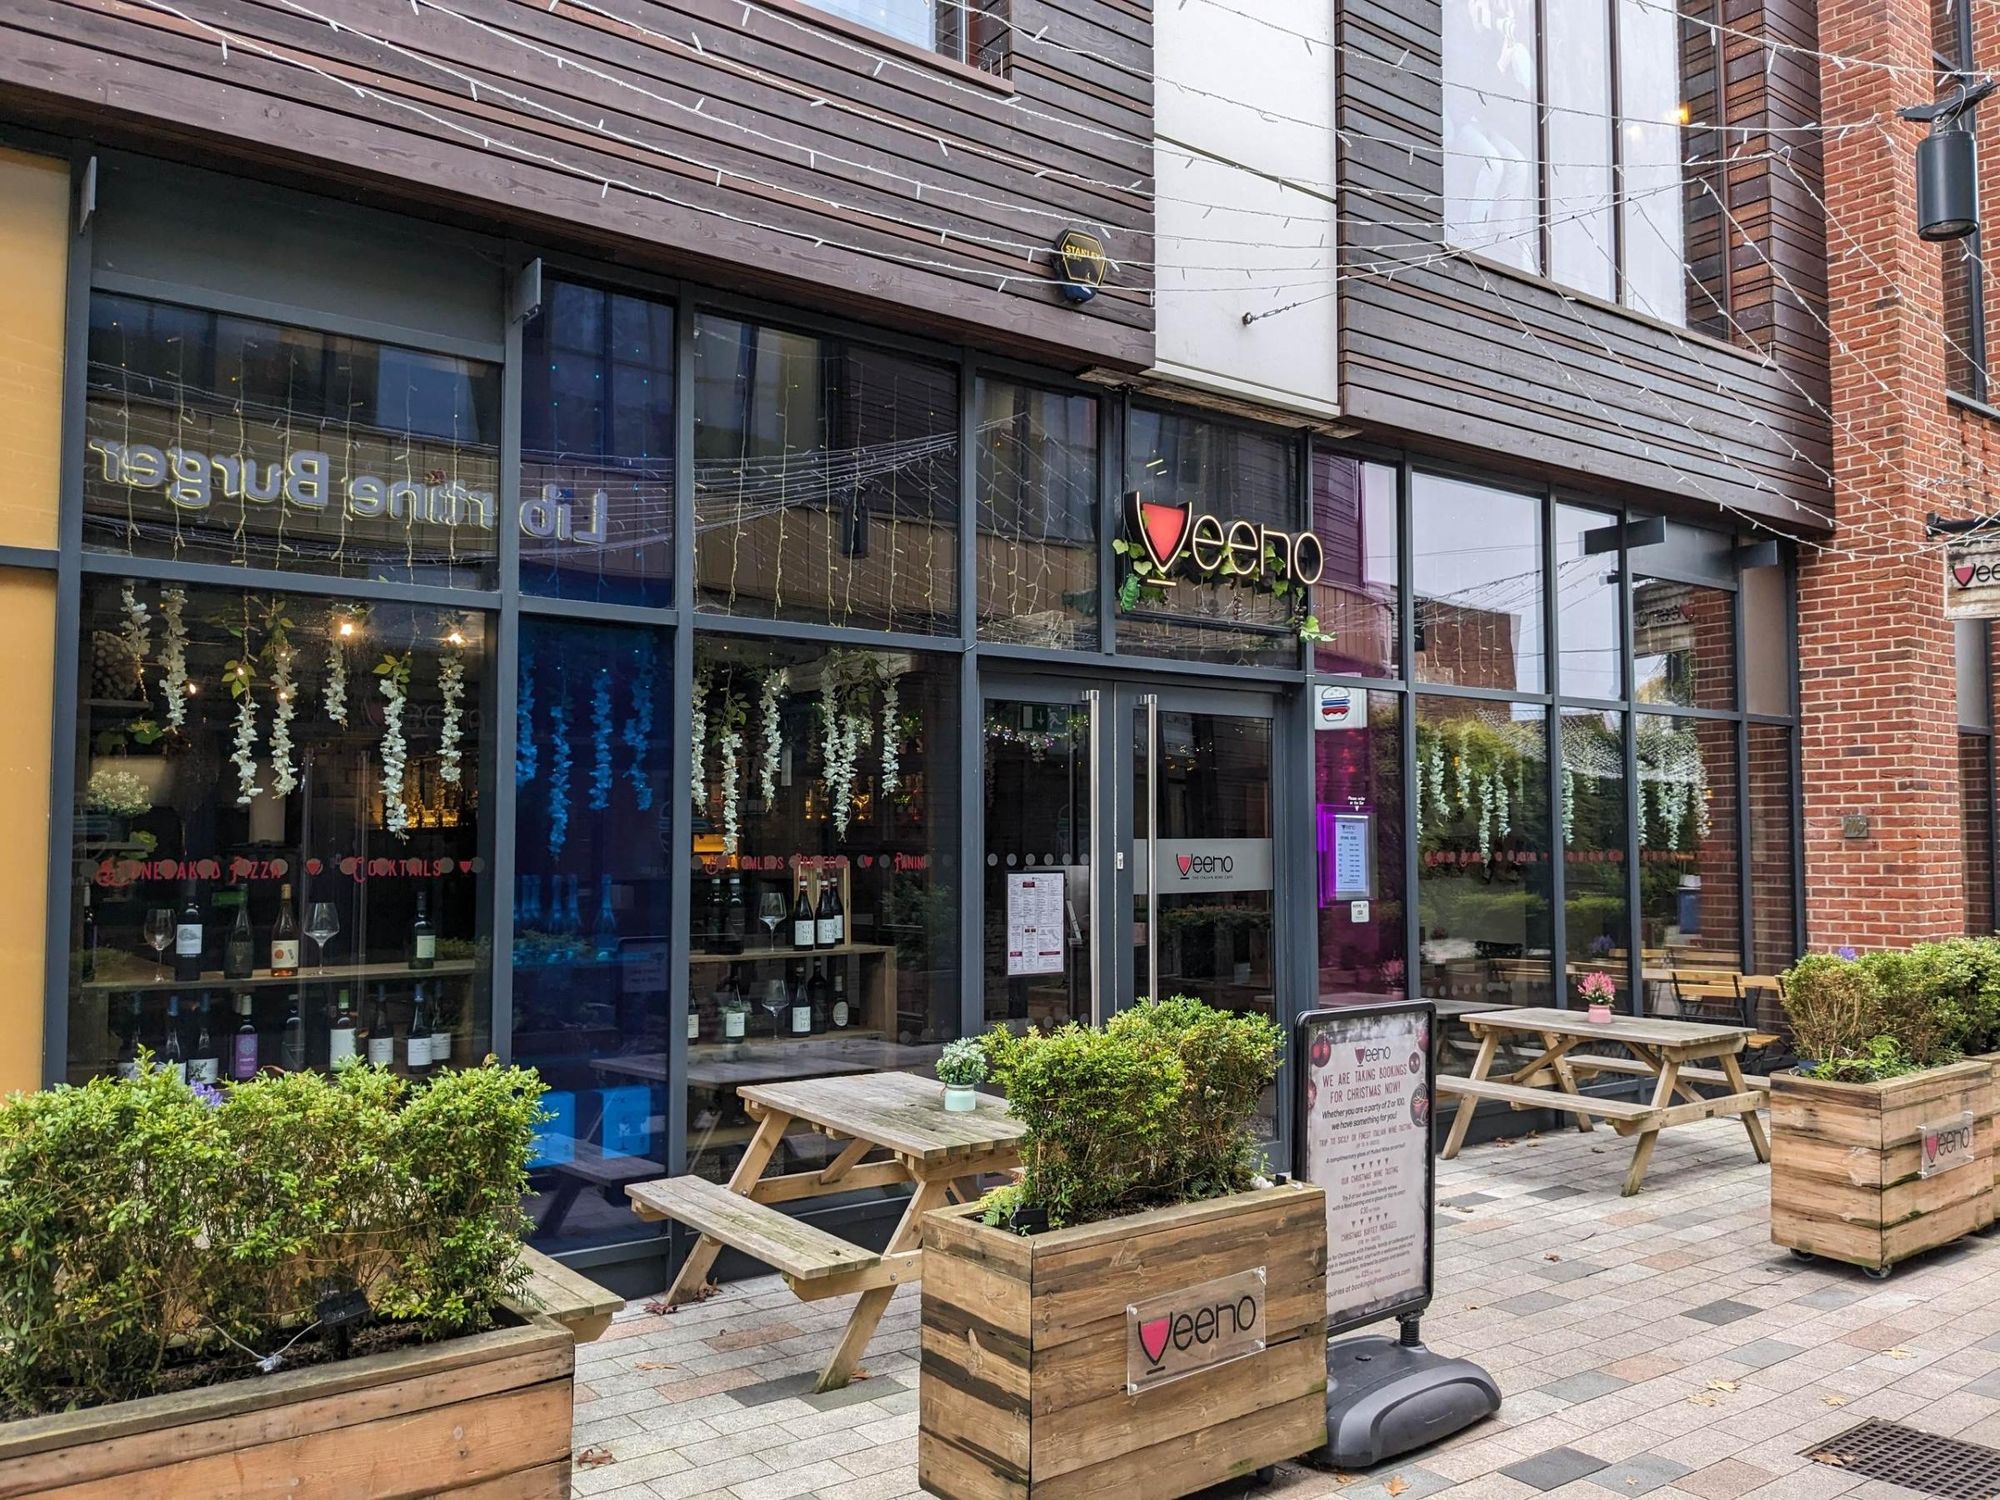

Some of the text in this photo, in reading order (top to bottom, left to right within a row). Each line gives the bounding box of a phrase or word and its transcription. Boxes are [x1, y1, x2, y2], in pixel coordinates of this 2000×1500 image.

[1065, 244, 1101, 260] STANLEY
[1136, 491, 1323, 586] Veeno
[1176, 853, 1234, 879] Veeno
[1354, 1045, 1391, 1067] Veeno
[1322, 1062, 1407, 1088] WE ARE TAKING BOOKINGS
[1330, 1080, 1400, 1104] FOR CHRISTMAS NOW!
[1321, 1107, 1344, 1119] Whether
[1345, 1107, 1354, 1117] you
[1355, 1106, 1363, 1114] are
[1368, 1102, 1380, 1112] party
[1340, 1120, 1351, 1128] have
[1353, 1114, 1379, 1128] something
[1925, 1126, 1970, 1169] Veeno
[1137, 1295, 1257, 1376] Veeno
